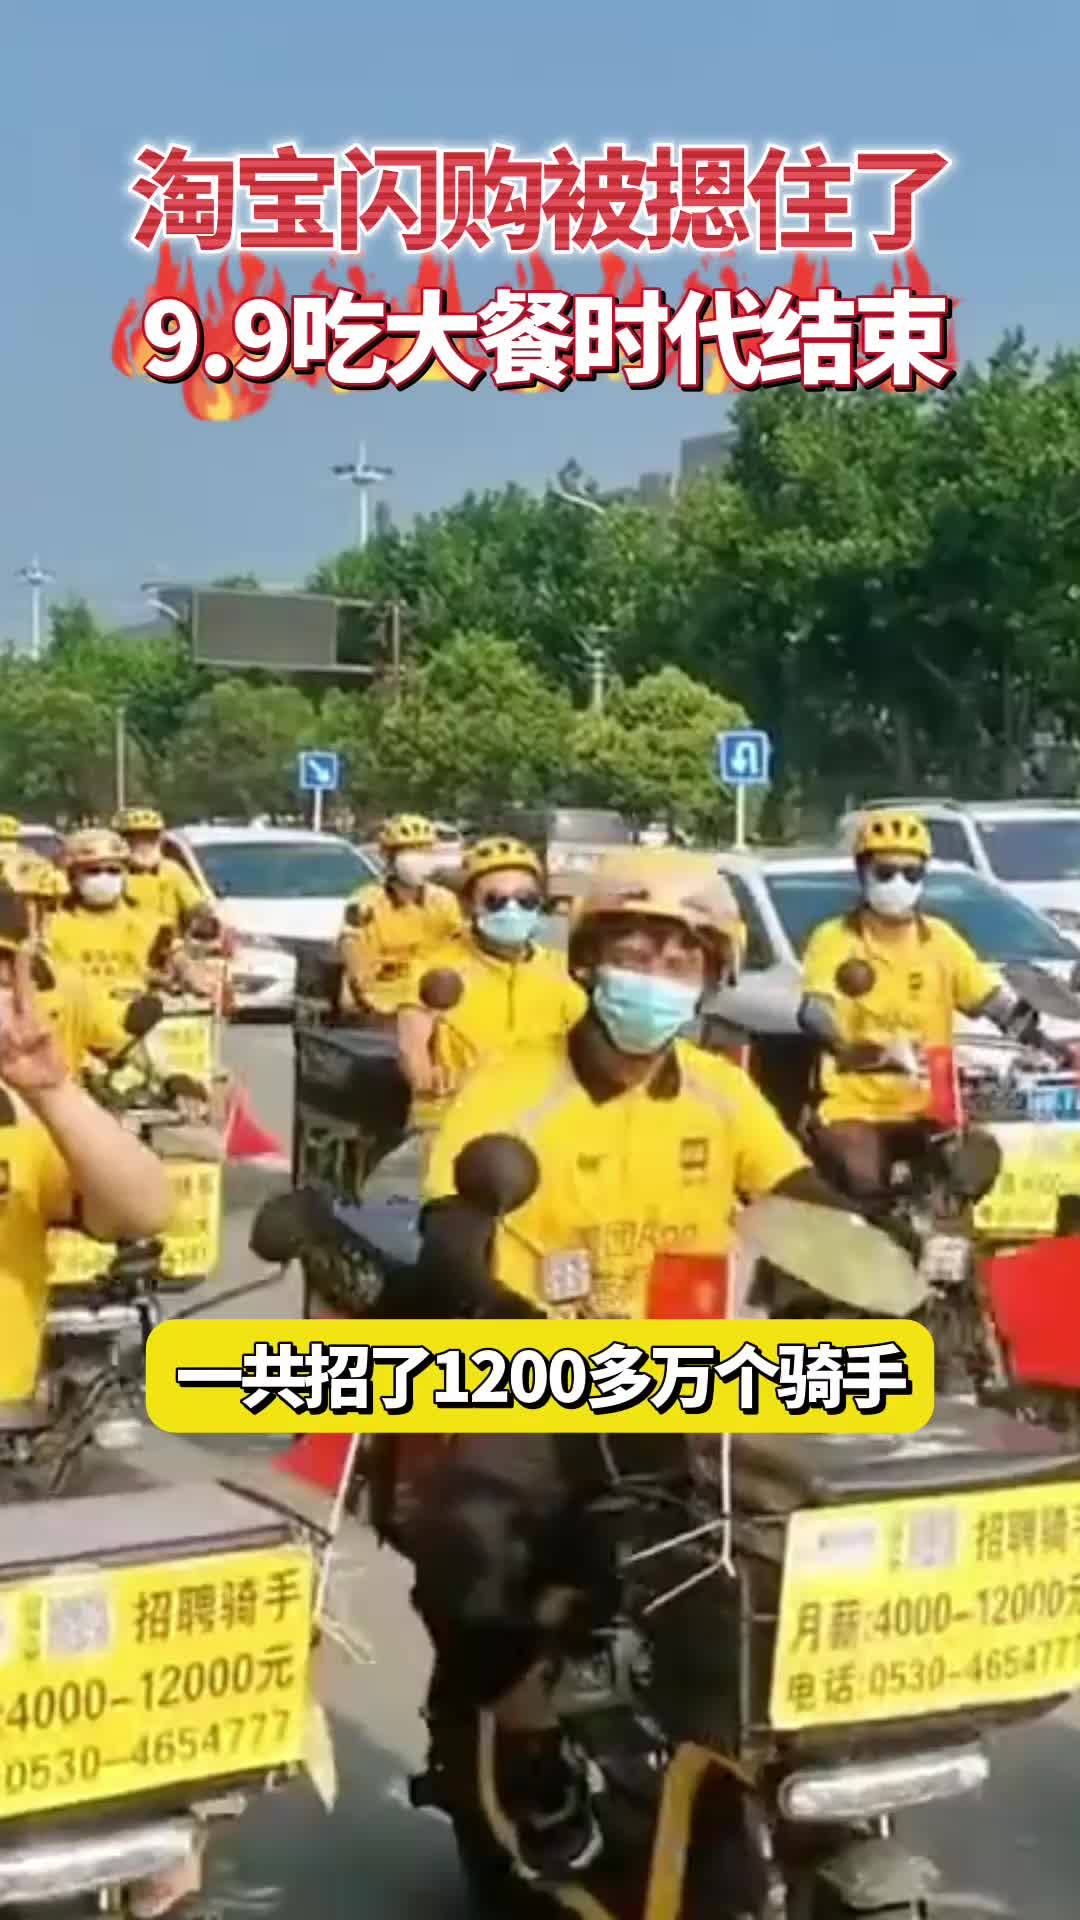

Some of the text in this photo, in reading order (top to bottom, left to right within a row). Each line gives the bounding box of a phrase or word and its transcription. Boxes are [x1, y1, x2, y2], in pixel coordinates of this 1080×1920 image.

[975, 1504, 1080, 1561] 招聘骑
[132, 1567, 303, 1643] 招聘骑手
